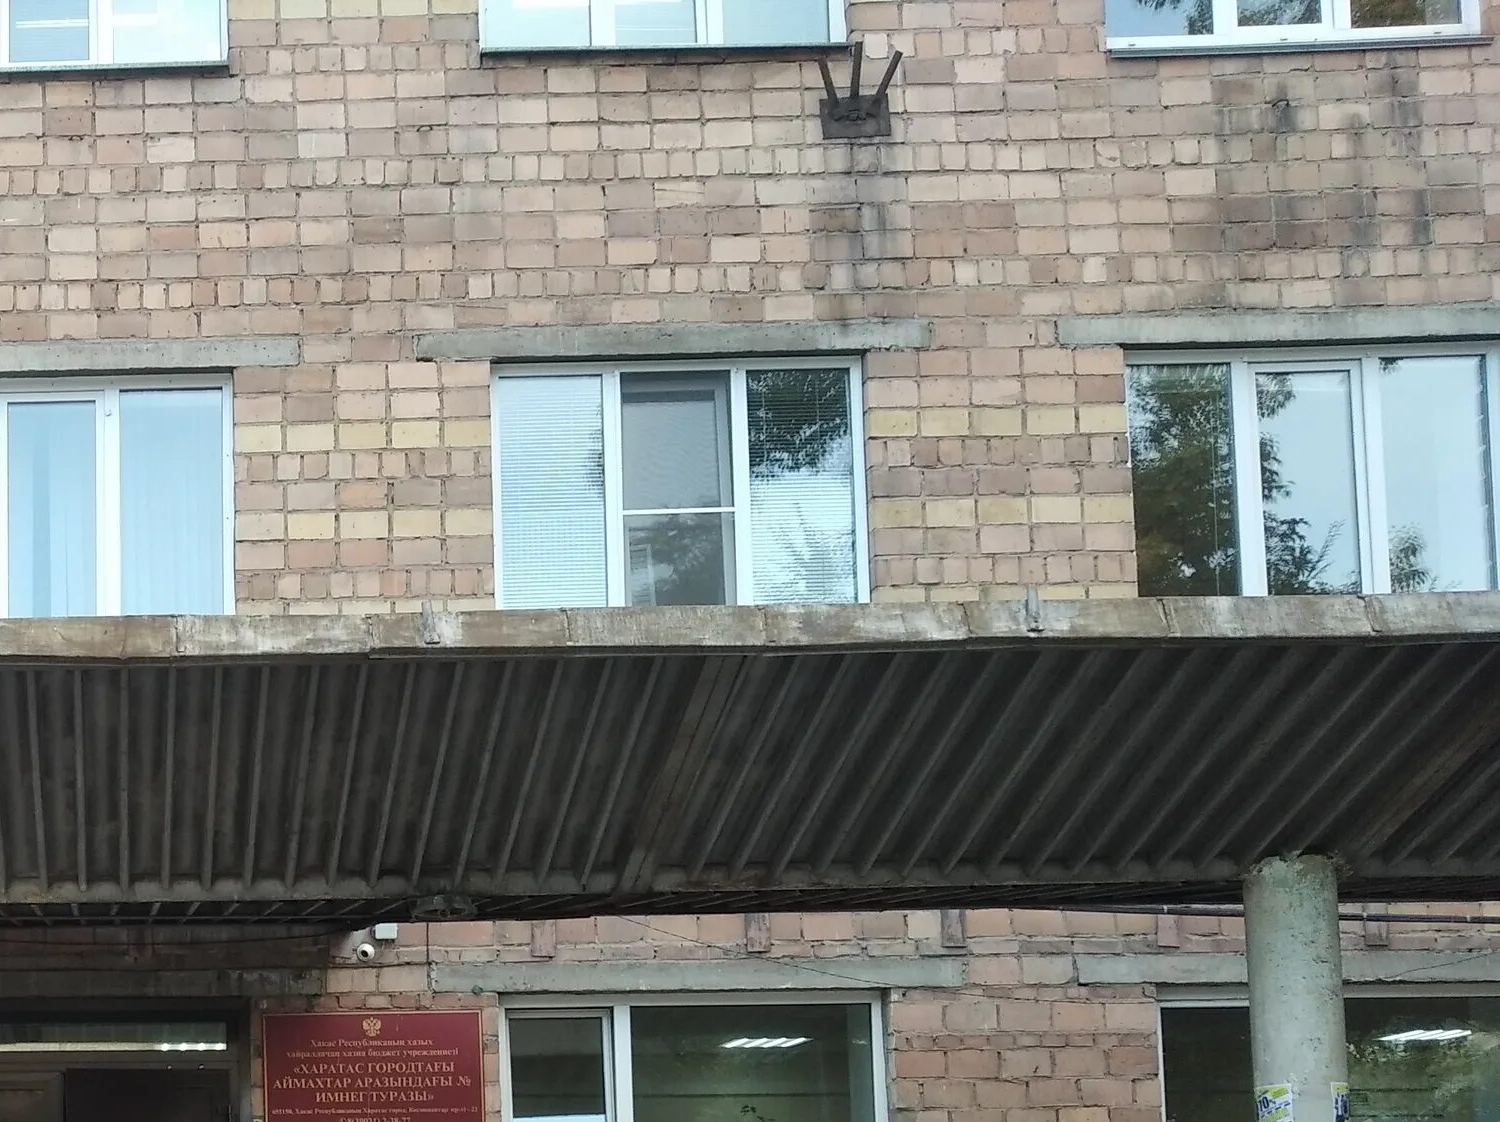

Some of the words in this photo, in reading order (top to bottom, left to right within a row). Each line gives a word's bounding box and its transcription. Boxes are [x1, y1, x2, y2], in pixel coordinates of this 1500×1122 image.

[368, 1048, 400, 1057] бюджет
[294, 1063, 365, 1075] «ХАРАТАС
[273, 1077, 351, 1089] АЙМАХТАР
